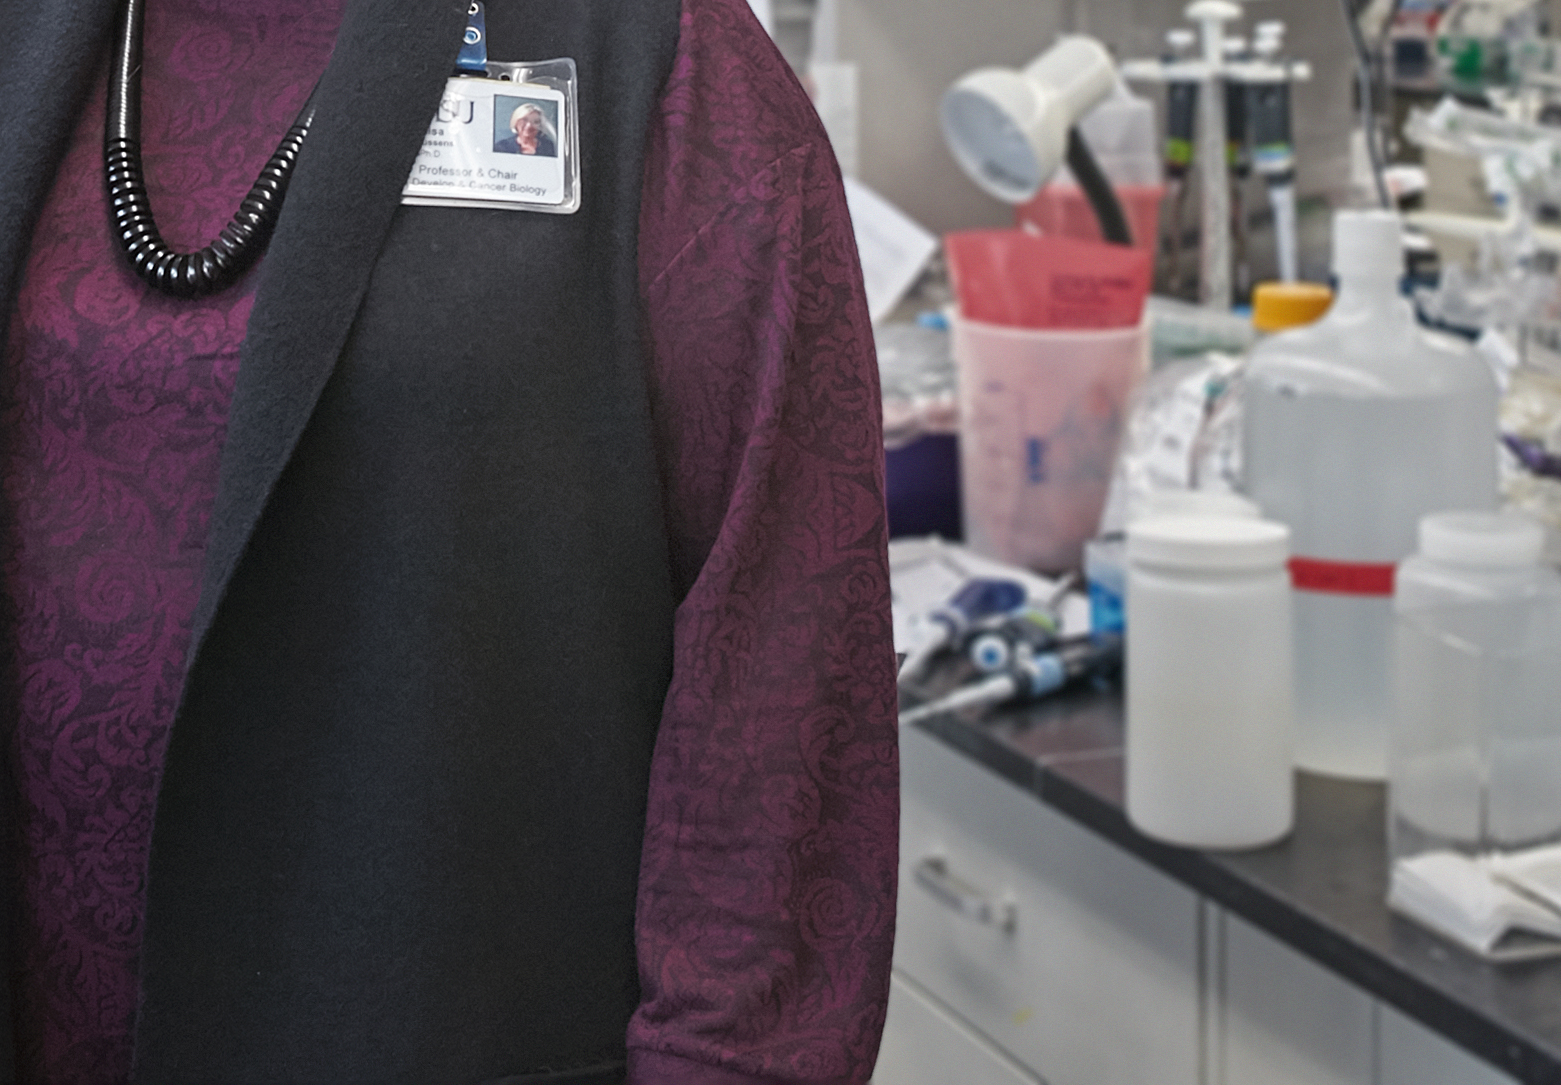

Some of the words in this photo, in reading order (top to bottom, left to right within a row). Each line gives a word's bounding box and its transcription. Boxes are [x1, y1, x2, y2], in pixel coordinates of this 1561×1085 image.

[418, 164, 473, 177] Professor
[476, 167, 485, 178] &
[488, 168, 519, 180] Chair
[469, 180, 506, 192] Cancer
[509, 183, 548, 196] Biology
